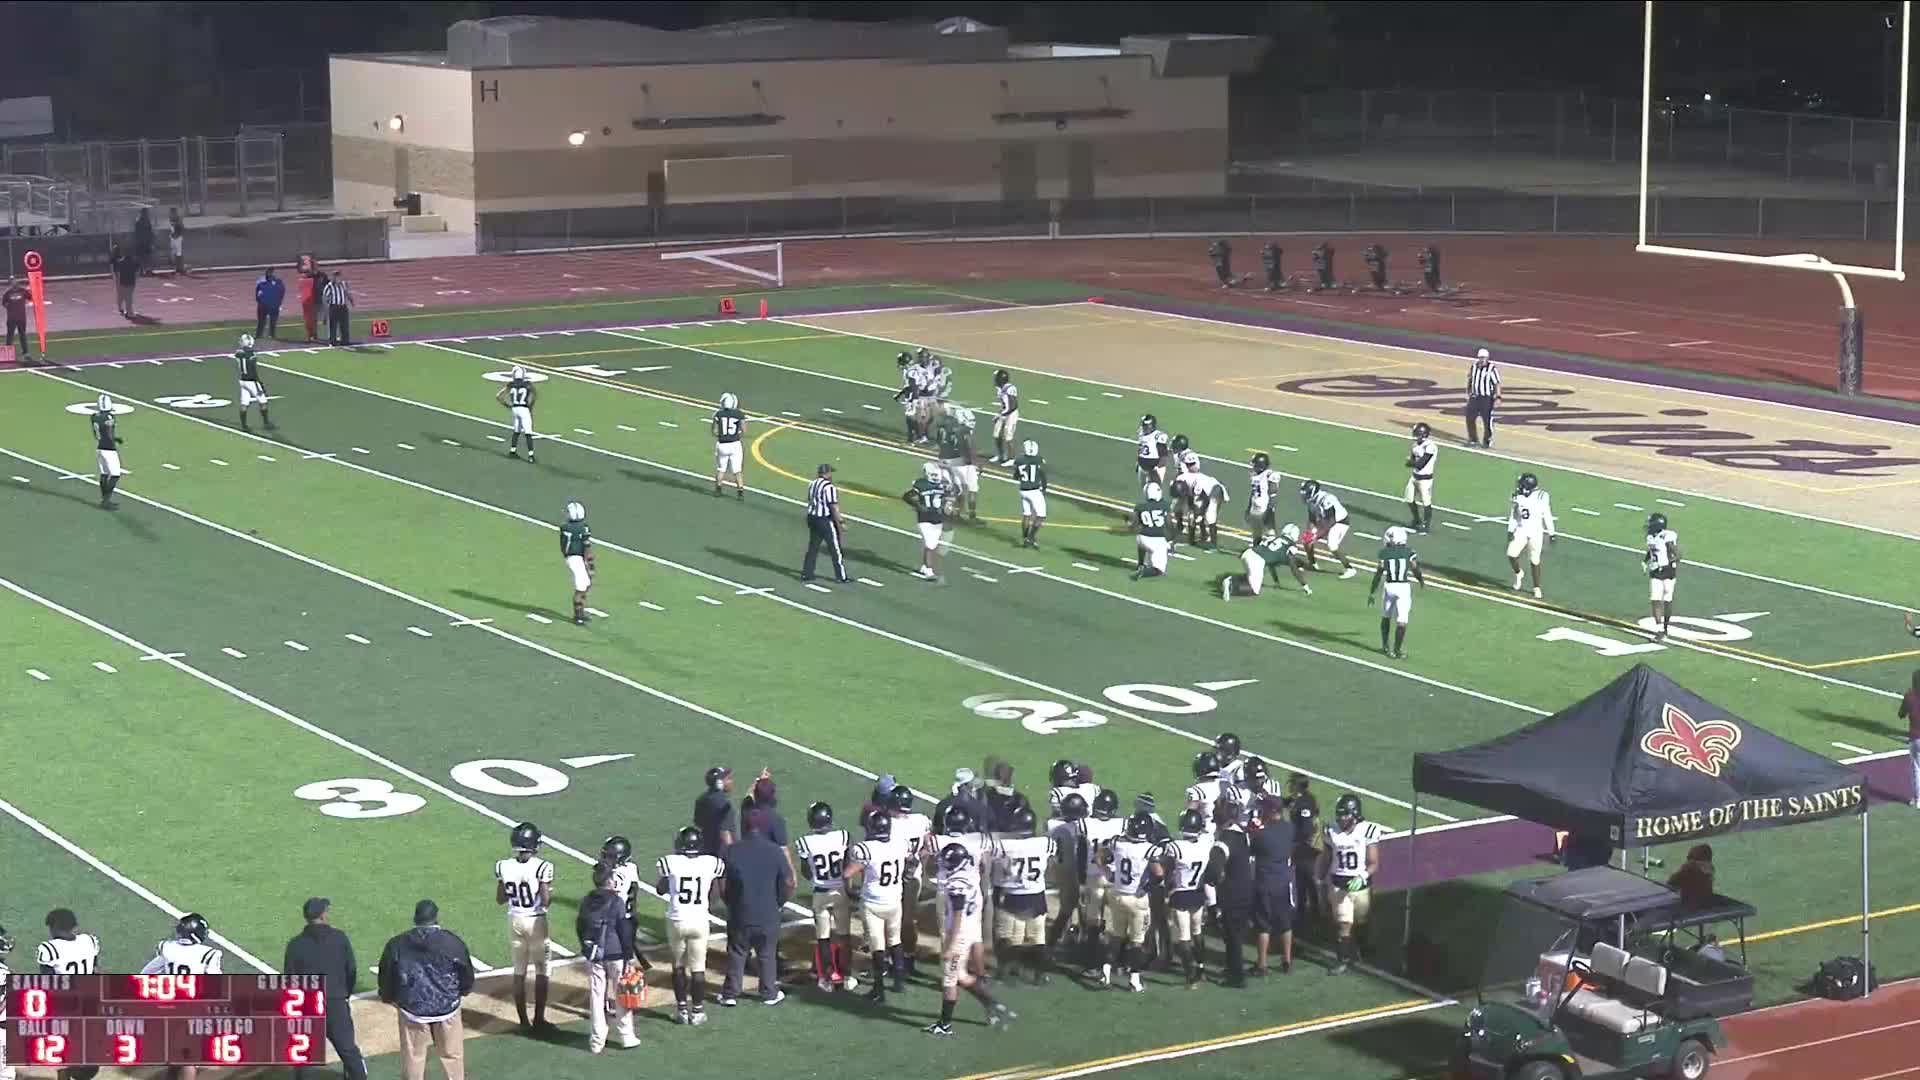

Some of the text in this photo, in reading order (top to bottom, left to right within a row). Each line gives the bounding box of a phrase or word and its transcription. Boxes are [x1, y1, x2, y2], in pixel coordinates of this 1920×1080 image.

[480, 79, 498, 103] H
[721, 416, 740, 436] 15
[1018, 463, 1037, 483] 51
[1388, 557, 1408, 581] 11
[1636, 784, 1863, 838] HOME OF THE SAINTS
[812, 850, 844, 882] 26
[879, 859, 900, 887] 61
[1013, 856, 1041, 882] 75
[1336, 850, 1359, 871] 10
[1188, 861, 1202, 887] 7
[504, 881, 534, 908] 20
[678, 876, 703, 905] 51
